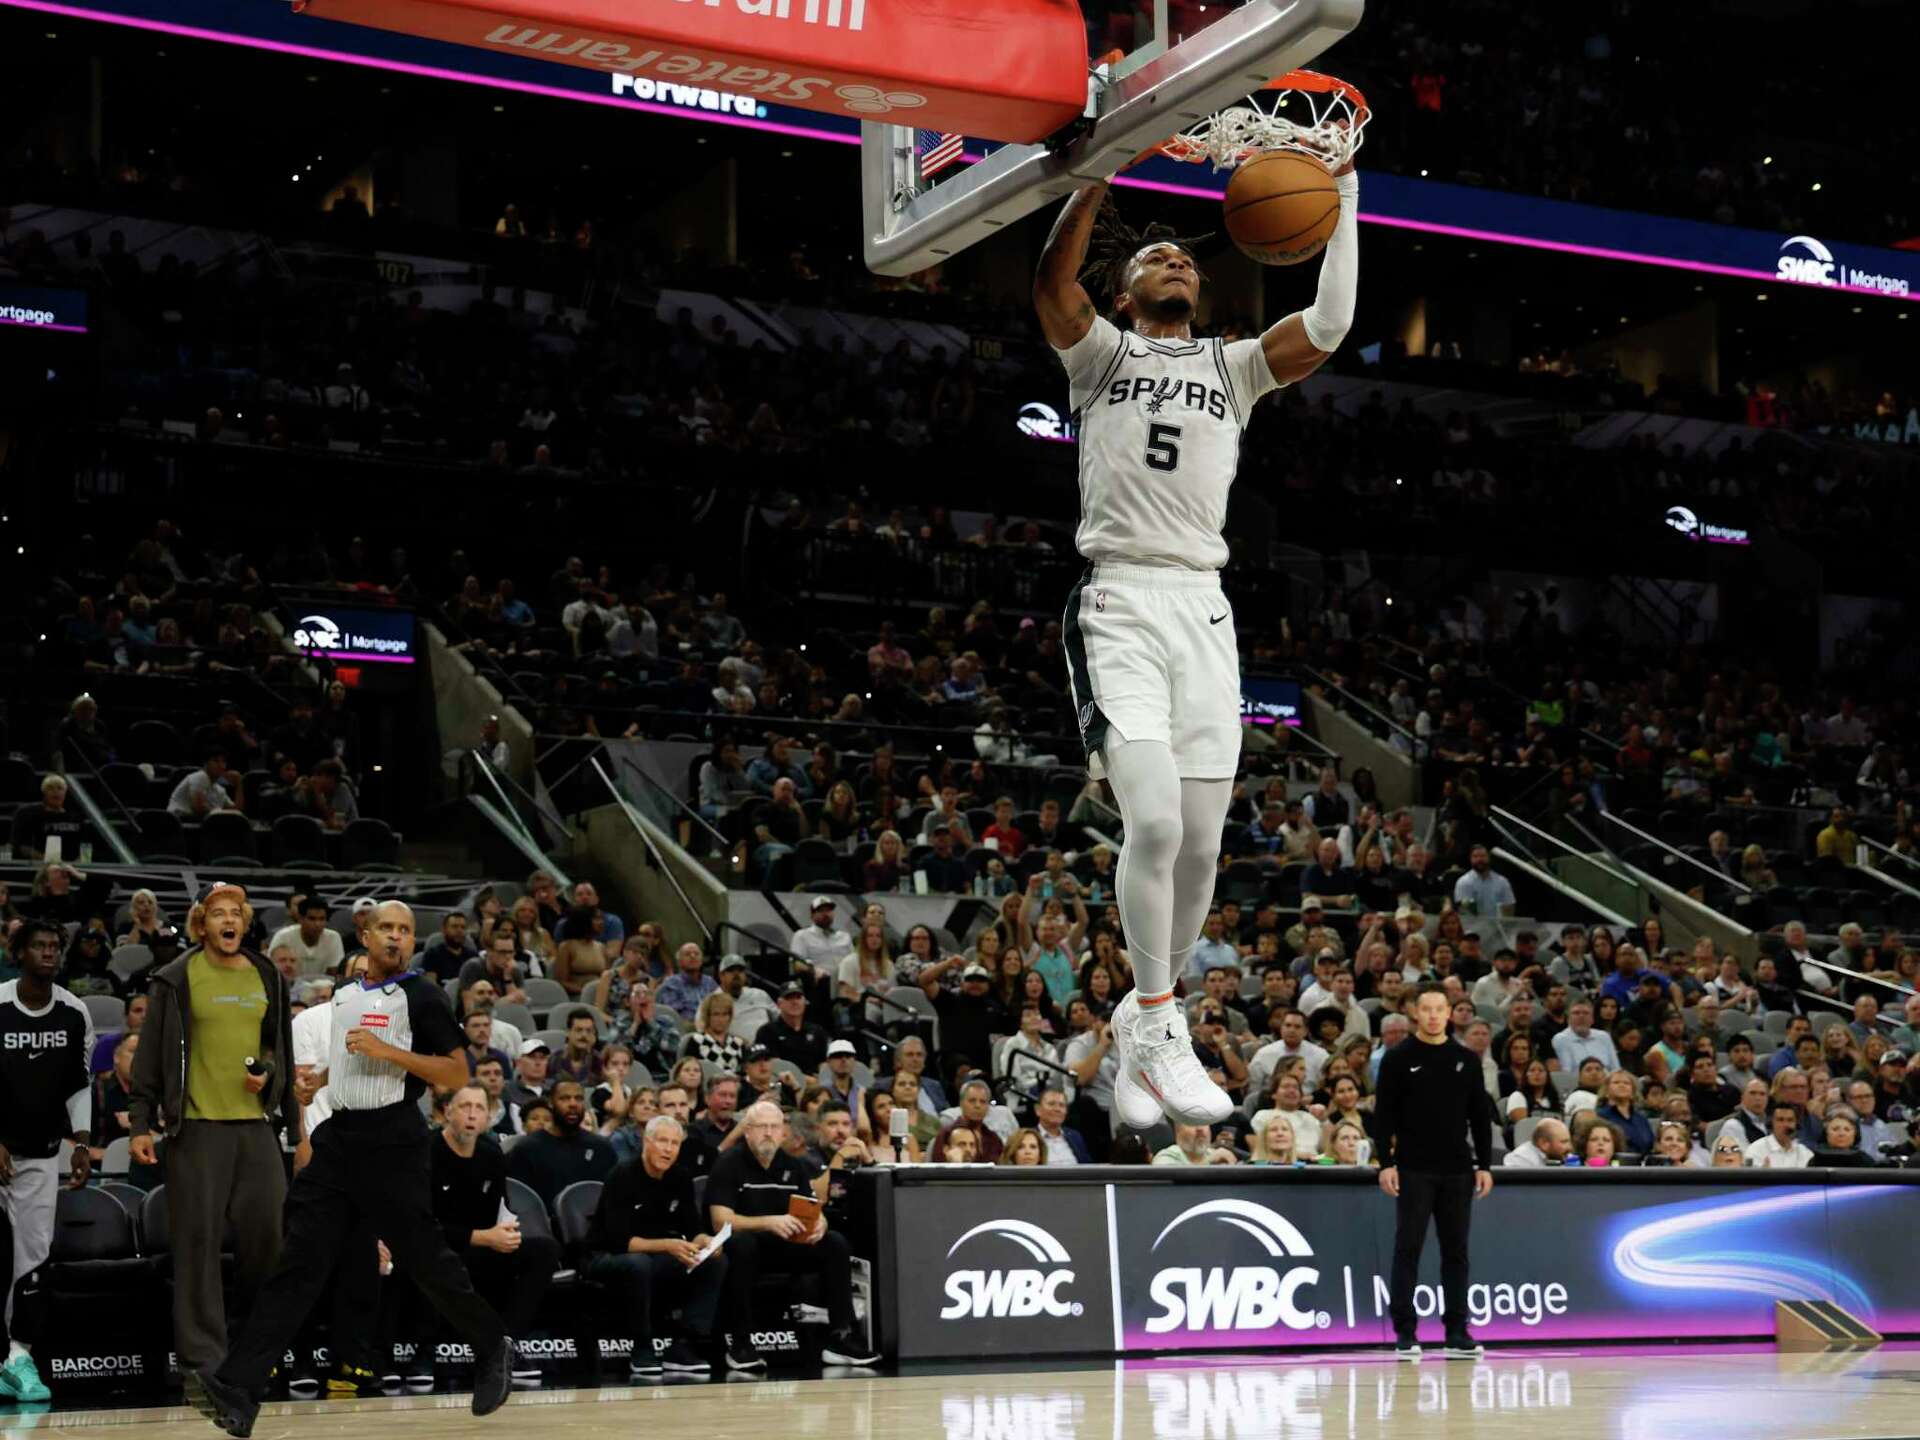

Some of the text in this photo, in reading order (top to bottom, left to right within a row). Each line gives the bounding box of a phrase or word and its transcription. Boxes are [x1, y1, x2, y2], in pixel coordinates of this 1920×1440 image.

[0, 305, 55, 325] ortgage
[1108, 376, 1227, 421] SPURS
[1143, 421, 1184, 475] 5
[351, 635, 408, 653] Mortgage
[4, 1029, 68, 1049] SPURS
[940, 1268, 1076, 1320] SWBC
[1145, 1266, 1568, 1333] SWBC orgage
[515, 1338, 577, 1354] RCODE
[51, 1355, 143, 1373] BARCODE
[52, 1368, 144, 1379] PERFORMANCE WATER
